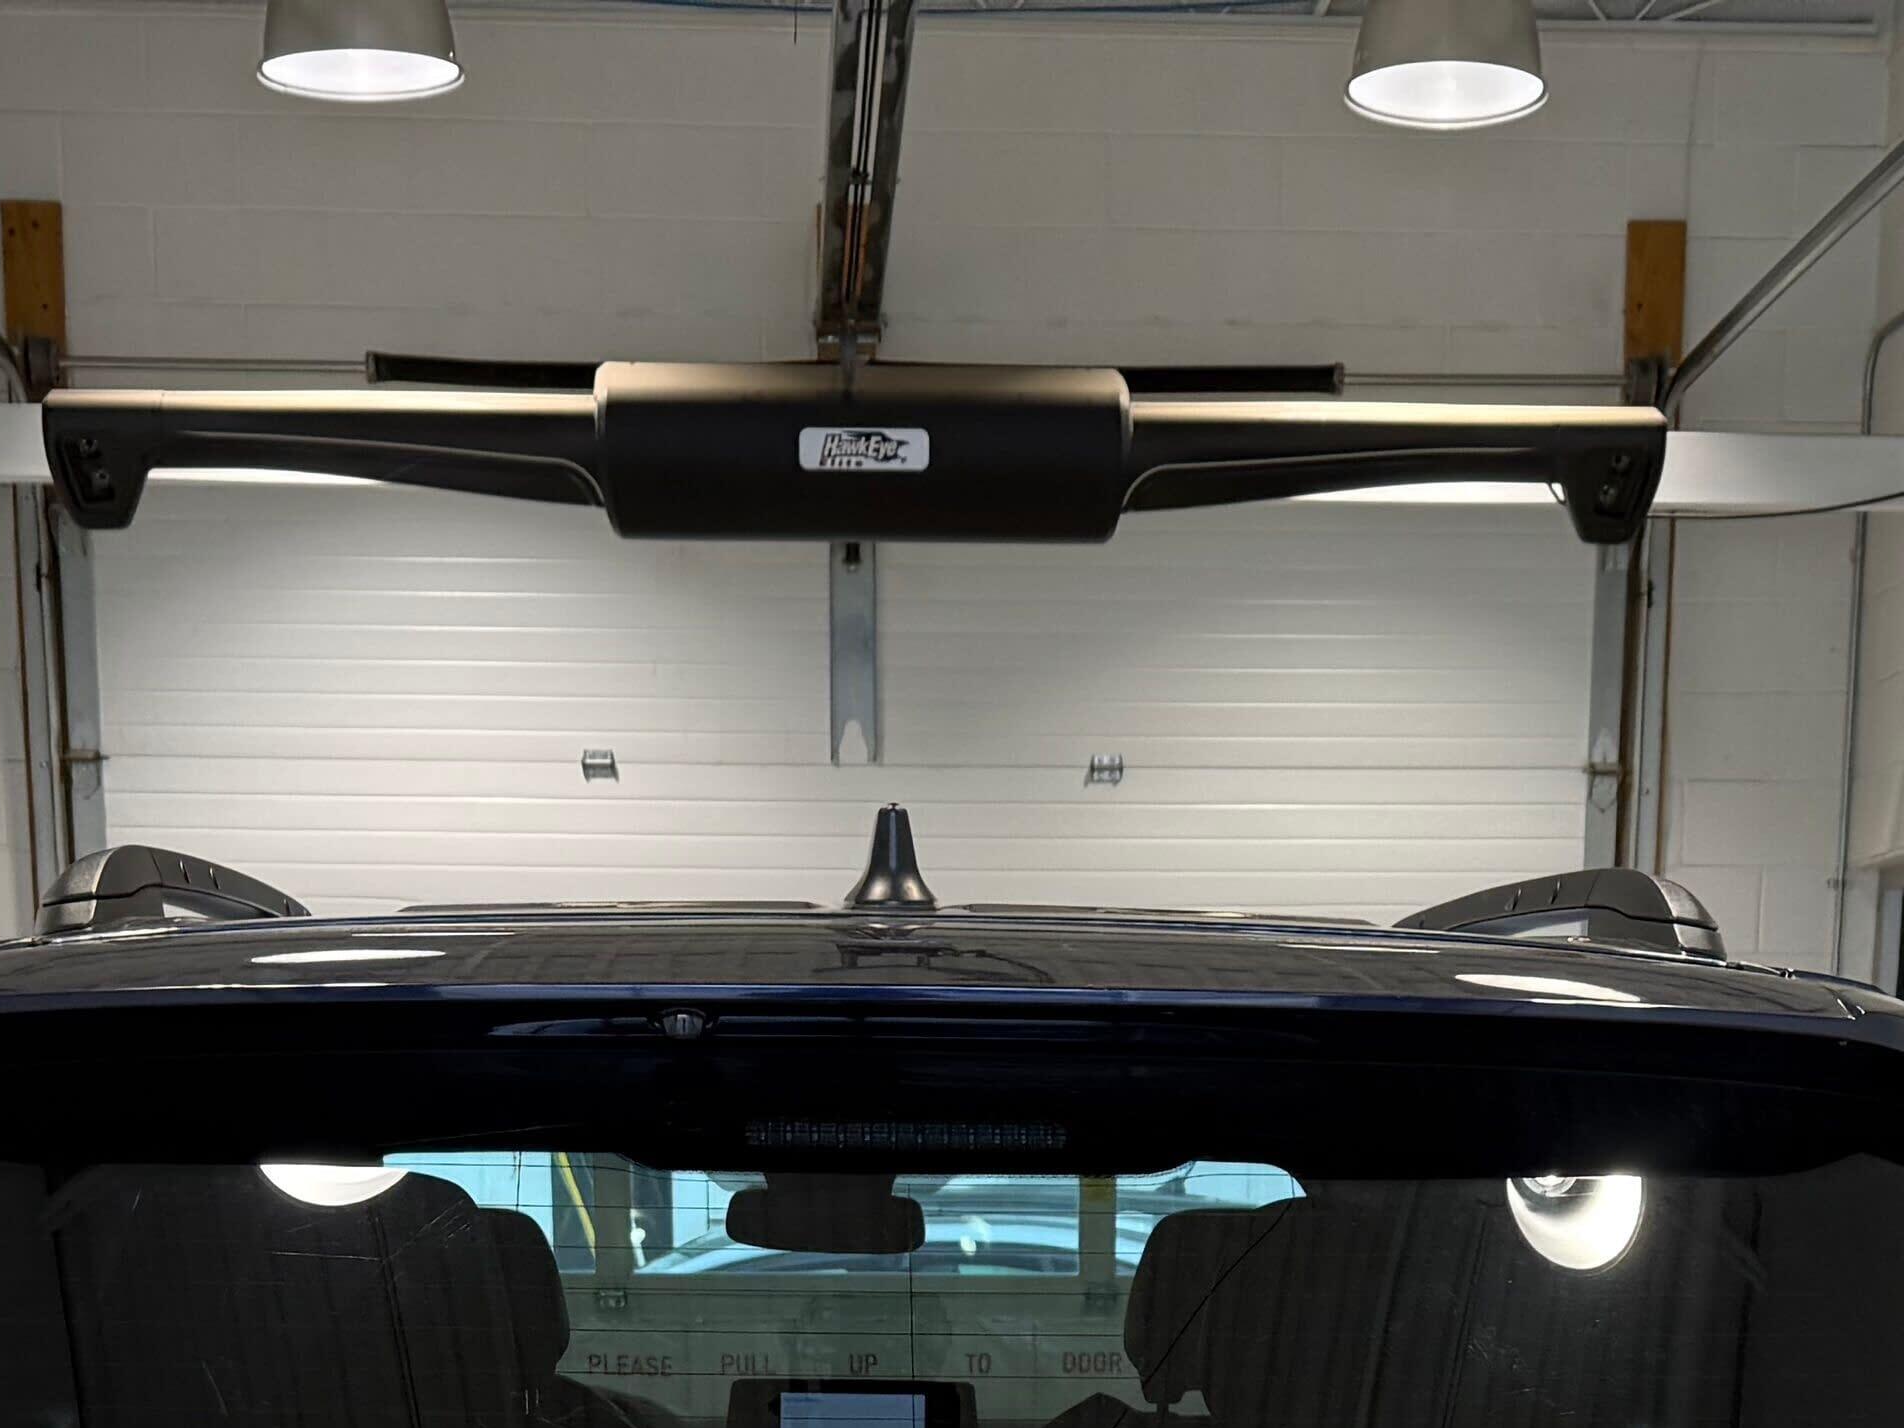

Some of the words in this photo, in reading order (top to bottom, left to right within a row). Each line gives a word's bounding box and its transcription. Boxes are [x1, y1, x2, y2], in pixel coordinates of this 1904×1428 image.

[586, 1353, 673, 1376] PLEASE
[720, 1353, 771, 1375] PULL
[848, 1353, 878, 1375] UP
[964, 1352, 992, 1374] TO
[1061, 1351, 1123, 1374] DOOR
